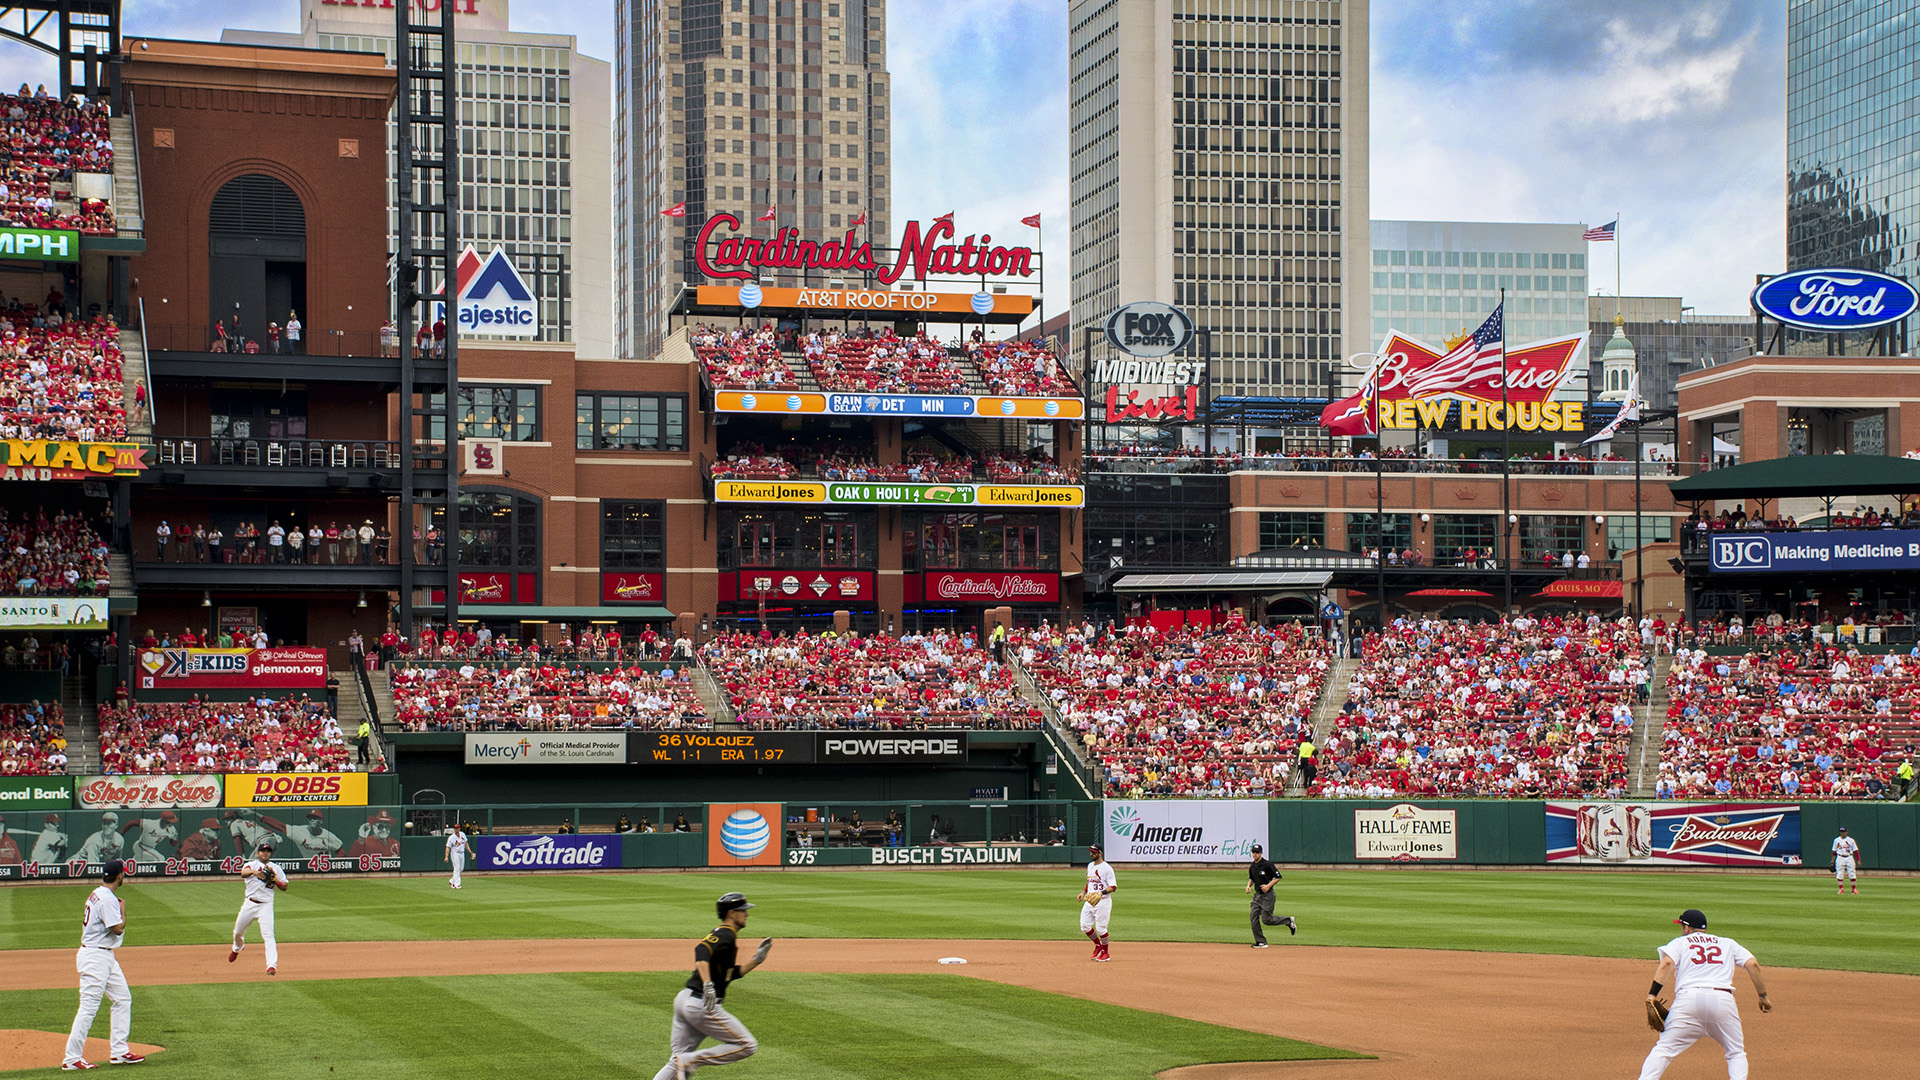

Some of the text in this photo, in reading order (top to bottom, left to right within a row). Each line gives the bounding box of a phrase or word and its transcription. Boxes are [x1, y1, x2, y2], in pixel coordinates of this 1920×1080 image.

[695, 213, 1035, 285] Cardinals Nation
[797, 290, 938, 310] AT&T ROOFTOP
[1789, 275, 1887, 317] Ford
[1124, 312, 1175, 336] FOX
[1124, 336, 1175, 346] SPORTS
[1094, 359, 1206, 384] MIDWEST
[1348, 351, 1579, 391] Biser
[834, 396, 862, 405] RAIN
[882, 399, 970, 412] DET MIN P
[1106, 385, 1198, 423] Live!
[1379, 399, 1451, 430] REW
[1461, 400, 1584, 431] HOUSE
[7, 438, 117, 474] MAC
[3, 468, 52, 481] AND
[729, 485, 815, 499] Edward Jones
[835, 487, 920, 500] OAK 0 HOU 1 4
[962, 493, 968, 502] 1
[990, 489, 1072, 503] Edward Jones
[1719, 542, 1764, 566] BJC
[1775, 545, 1830, 562] Making
[1834, 544, 1904, 559] Medicine
[938, 575, 1048, 598] Cardinals Nation
[1551, 584, 1583, 593] LOUIS,
[1585, 584, 1600, 593] MO
[2, 607, 48, 616] SANTO
[200, 654, 248, 672] KIDS
[273, 650, 324, 660] Cardinal Glennon
[253, 664, 323, 676] glennon.org
[144, 678, 152, 687] K
[659, 734, 755, 747] 36 VOLQUEZ
[474, 743, 519, 760] Mercy
[653, 749, 672, 760] WL
[721, 749, 745, 760] ERA
[754, 749, 784, 760] 1.97
[0, 786, 70, 800] onal Bank
[160, 778, 216, 803] Save
[254, 776, 342, 795] DOBBS
[272, 794, 279, 802] &
[1131, 823, 1203, 842] Ameren
[1360, 820, 1452, 834] HALL of FAME
[1669, 823, 1779, 842] Budweiser
[493, 841, 605, 866] Scottrade
[1130, 845, 1175, 855] FOCUSED
[1221, 839, 1239, 856] For
[1240, 838, 1257, 857] Lif
[1368, 841, 1443, 852] Edward Jones
[788, 850, 818, 864] 375'
[872, 847, 1022, 864] BUSCH STADIUM
[21, 860, 39, 877] 14
[40, 867, 61, 875] BOYER
[68, 859, 87, 877] 17
[115, 858, 137, 876] 0
[137, 864, 157, 873] BROCK
[165, 857, 188, 875] 24
[189, 863, 212, 872] HERZOG
[220, 856, 244, 873] 42
[308, 854, 331, 872] 45
[331, 861, 353, 870] GIBSON
[358, 853, 382, 871] 85
[382, 860, 401, 868] BUSCH
[1093, 883, 1104, 891] 33
[1686, 935, 1719, 944] ADAMS
[1689, 944, 1723, 965] 32
